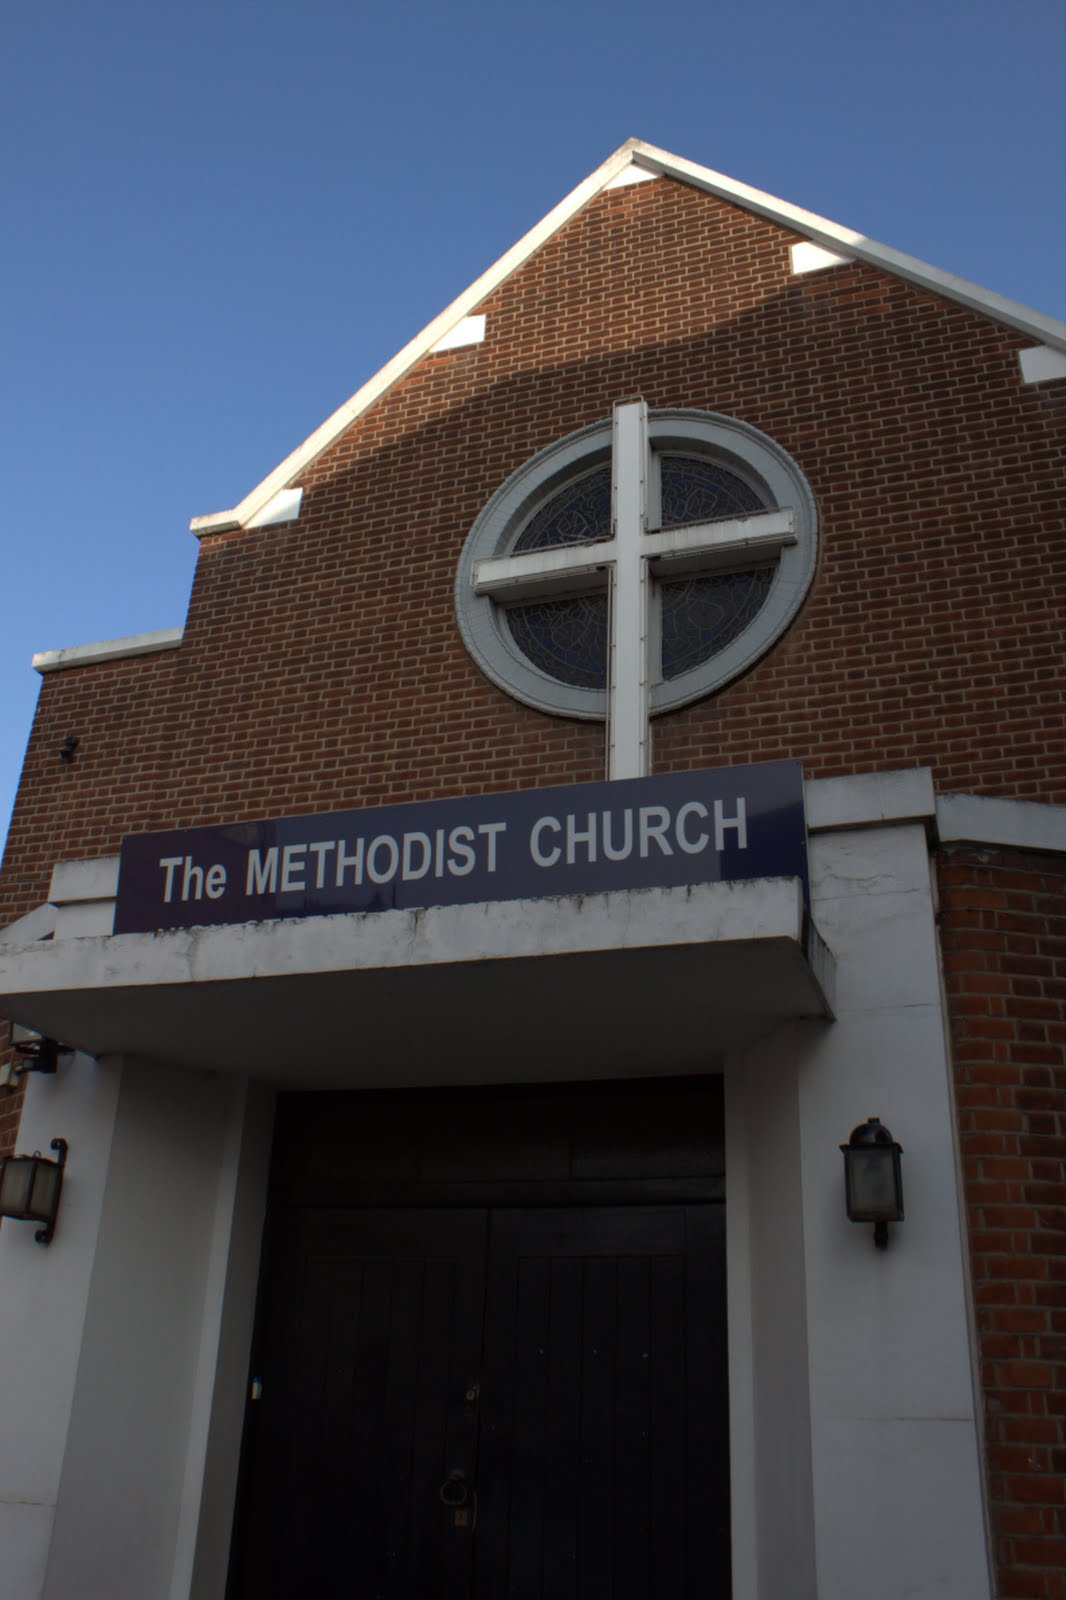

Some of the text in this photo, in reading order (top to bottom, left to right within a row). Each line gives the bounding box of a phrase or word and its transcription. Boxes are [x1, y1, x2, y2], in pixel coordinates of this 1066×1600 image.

[160, 797, 748, 902] The METHODIST CHURCH
